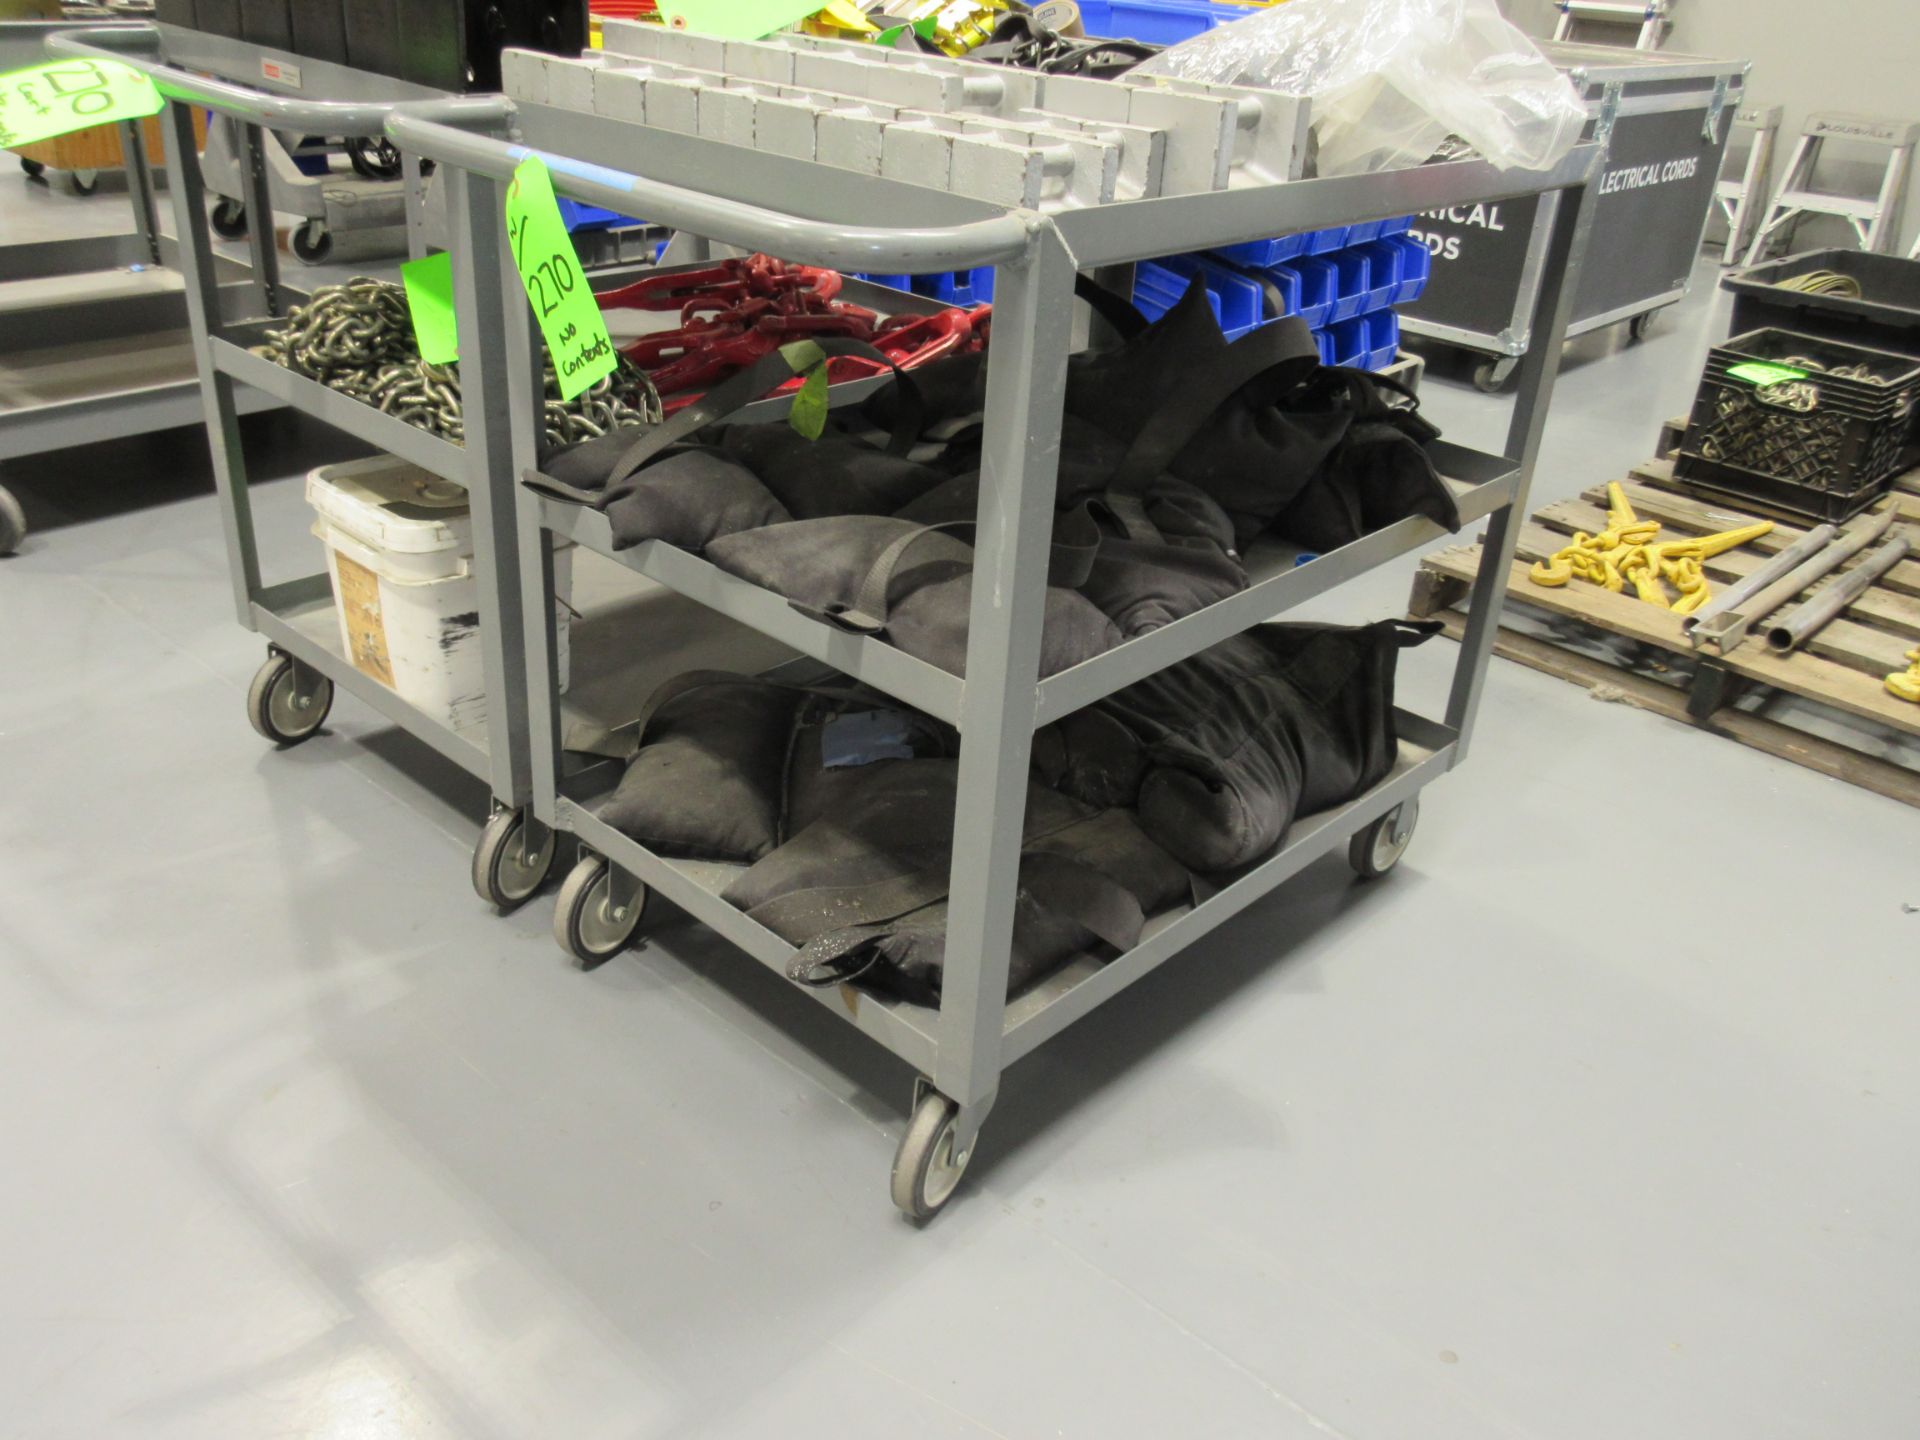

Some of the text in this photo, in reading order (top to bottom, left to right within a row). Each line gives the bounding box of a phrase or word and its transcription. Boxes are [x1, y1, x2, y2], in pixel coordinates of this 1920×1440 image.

[42, 60, 115, 115] 270
[1598, 156, 1698, 195] LECTRICAL CORDS
[528, 253, 575, 319] 270
